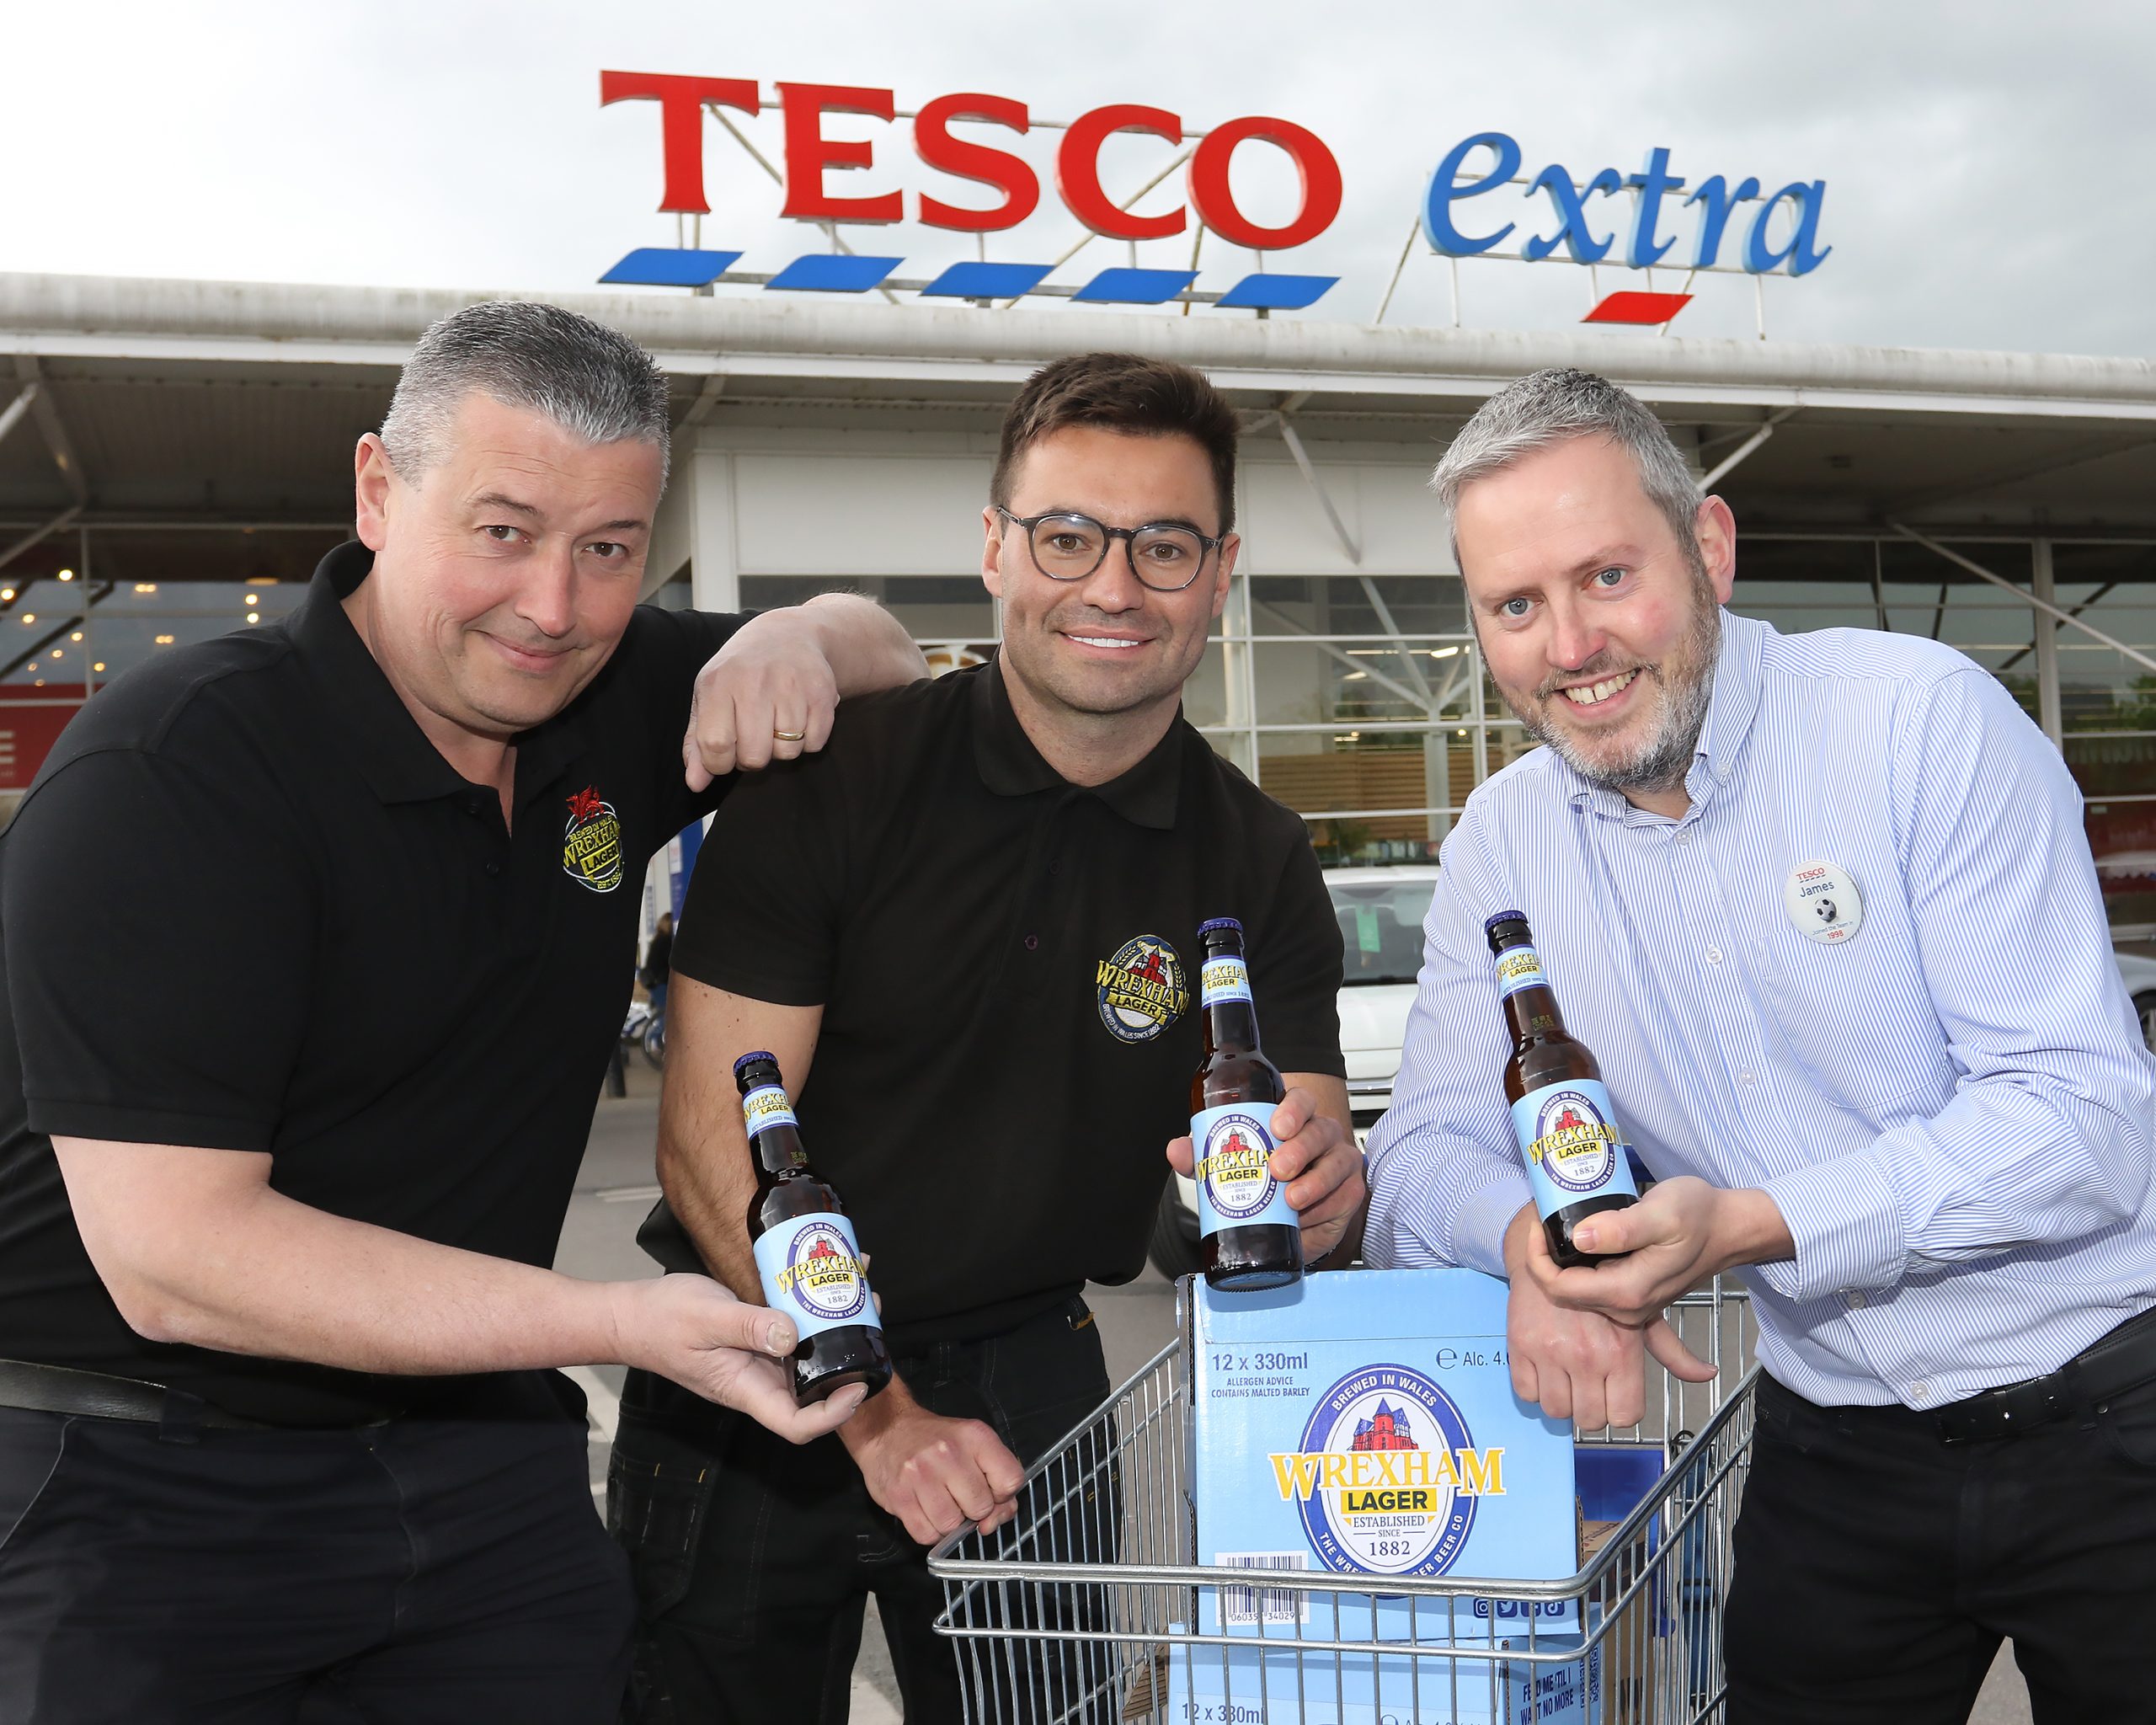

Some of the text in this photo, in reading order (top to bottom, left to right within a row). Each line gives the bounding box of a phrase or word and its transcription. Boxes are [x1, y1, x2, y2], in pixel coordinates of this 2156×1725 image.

[599, 70, 1343, 251] TESCO
[1422, 131, 1832, 278] extra
[585, 845, 618, 871] LAGER
[1796, 867, 1825, 880] TESCO
[1799, 881, 1834, 898] James
[1827, 929, 1844, 940] 1998
[1509, 965, 1538, 978] LAGER
[1208, 979, 1235, 990] LAGER
[1116, 995, 1159, 1016] LAGER
[1117, 1027, 1134, 1039] WALES
[1134, 1030, 1149, 1039] SINCE
[760, 1104, 789, 1115] LAGER
[1540, 1095, 1561, 1117] BREWED
[1570, 1092, 1590, 1105] WALES
[1209, 1118, 1230, 1138] BREWED
[1240, 1116, 1261, 1131] WALES
[1527, 1123, 1622, 1165] WREXHAM
[1559, 1142, 1598, 1159] LAGER
[1196, 1150, 1276, 1184] WREXHA
[1564, 1153, 1598, 1167] ESTABLISHED
[1219, 1169, 1258, 1183] LAGER
[1574, 1166, 1596, 1177] 1882
[1223, 1181, 1257, 1190] ESTABLISHED
[1560, 1181, 1591, 1191] WREXHAM
[1592, 1175, 1609, 1188] LAGER
[1230, 1193, 1252, 1202] 1882
[1216, 1204, 1244, 1217] WREXHAM
[1245, 1203, 1265, 1216] LAGER
[793, 1225, 814, 1247] BREWED
[824, 1224, 843, 1239] WALES
[811, 1273, 851, 1287] LAGER
[816, 1284, 851, 1294] ESTABLISHED
[827, 1295, 849, 1305] 1882
[811, 1307, 844, 1318] WREXHAM
[844, 1306, 861, 1316] LAGER
[1212, 1352, 1308, 1371] 12 x 330ml
[1462, 1351, 1488, 1366] Alc.
[1226, 1375, 1294, 1386] ALLERGEN ADVICE
[1211, 1386, 1310, 1398] CONTAINS MALTED BARLEY
[1331, 1374, 1438, 1412] BREWED IN WALES
[1269, 1449, 1505, 1499] WREXHAM
[1348, 1490, 1428, 1511] LAGER
[1353, 1514, 1425, 1528] ESTABLISHED
[1378, 1529, 1401, 1537] SINCE
[1433, 1514, 1464, 1564] BEER CO
[1319, 1531, 1337, 1556] THE
[1369, 1541, 1411, 1557] 1882
[1523, 1680, 1541, 1703] FED
[1543, 1674, 1554, 1695] ME
[1182, 1702, 1199, 1720] 12
[1204, 1707, 1213, 1721] x
[1520, 1688, 1574, 1725] WAT NO MORE
